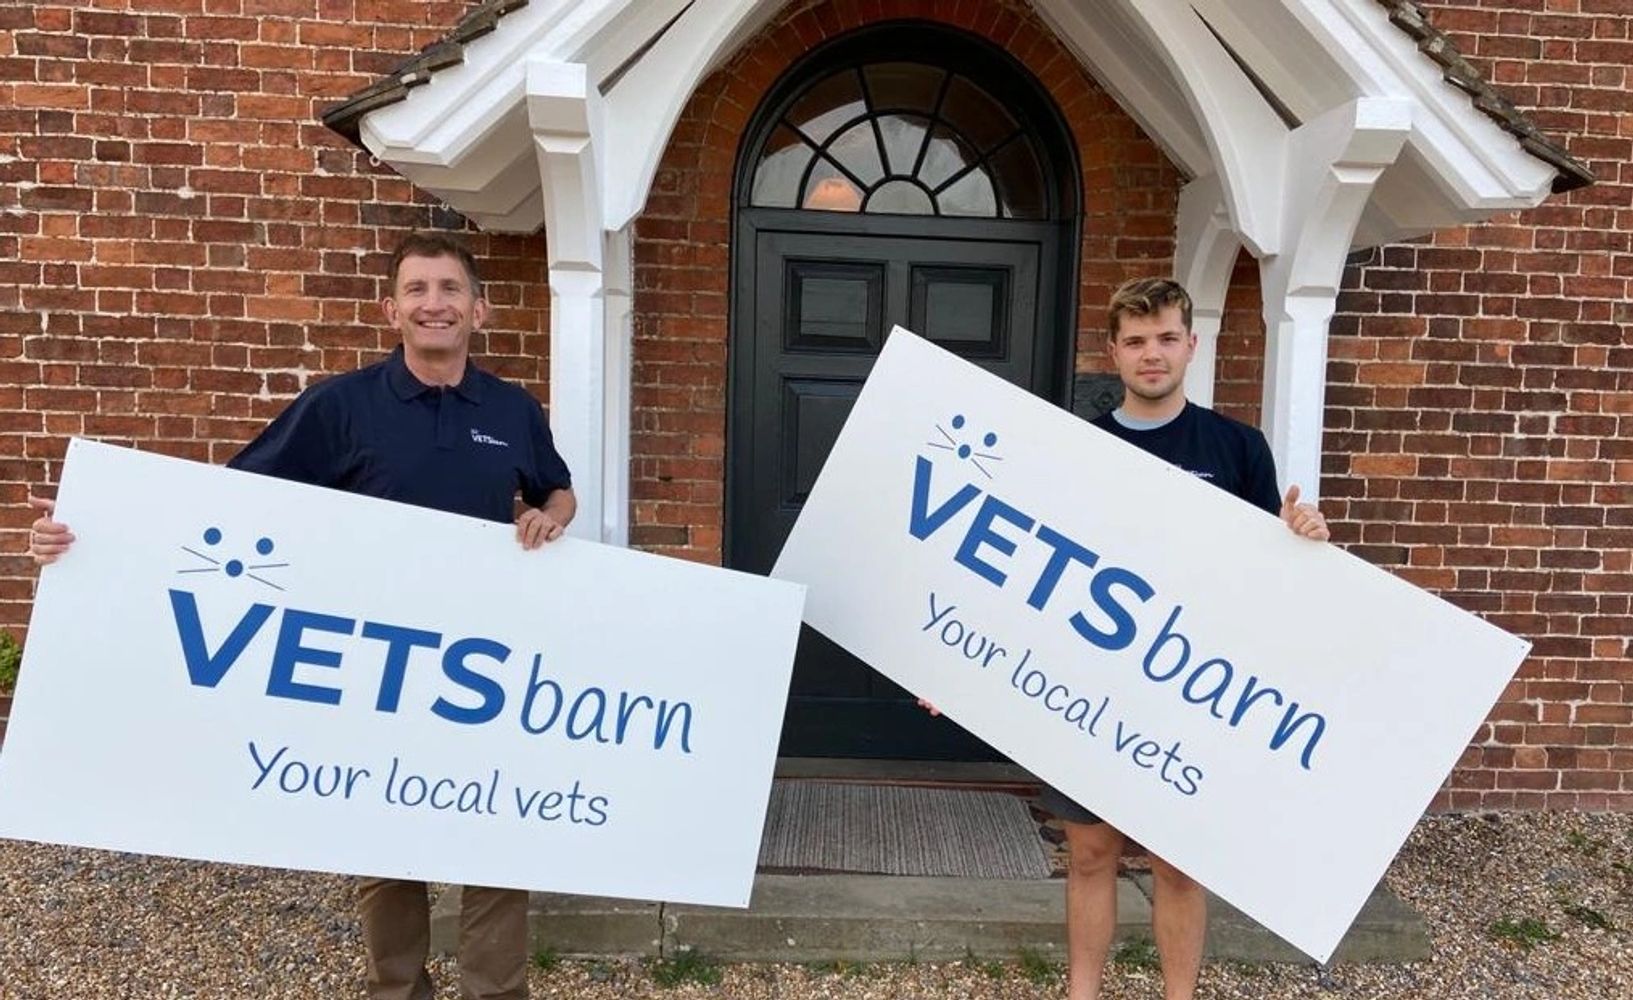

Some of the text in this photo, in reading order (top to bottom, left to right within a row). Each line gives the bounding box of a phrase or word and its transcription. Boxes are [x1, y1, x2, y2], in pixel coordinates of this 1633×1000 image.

[922, 592, 1204, 797] Your local vets
[248, 741, 609, 827] Your local vets
